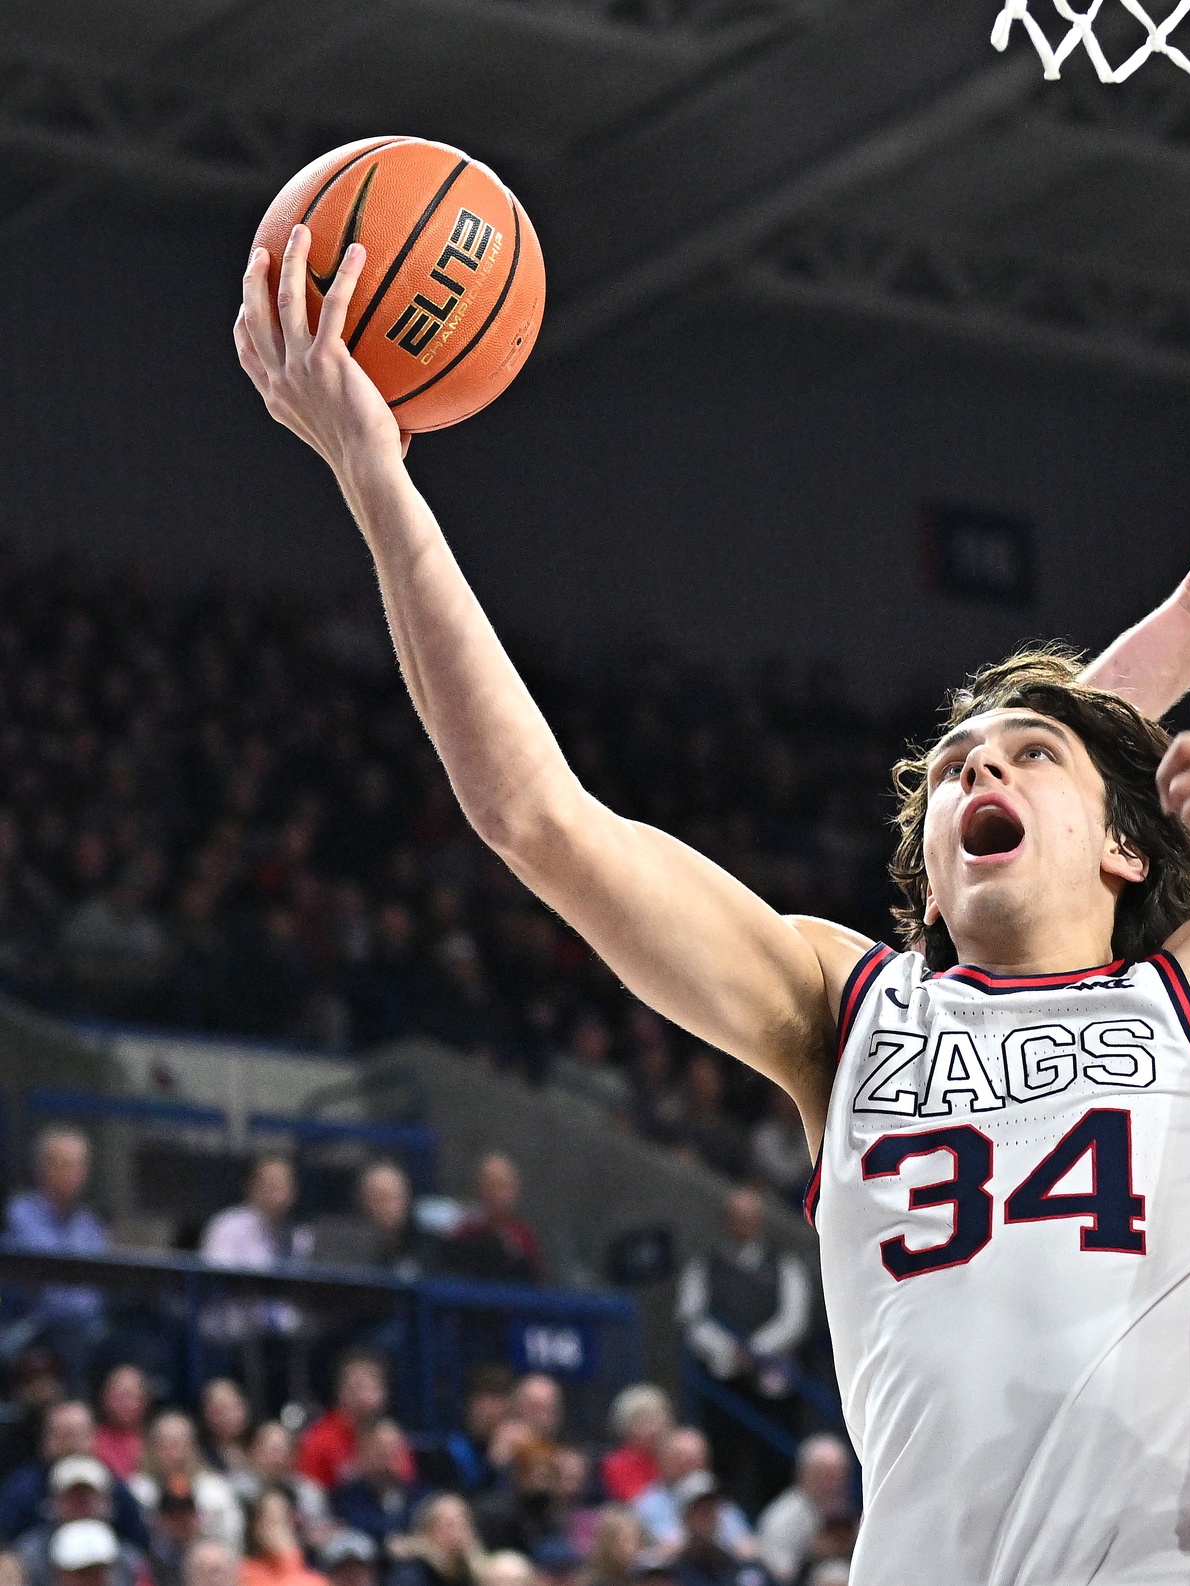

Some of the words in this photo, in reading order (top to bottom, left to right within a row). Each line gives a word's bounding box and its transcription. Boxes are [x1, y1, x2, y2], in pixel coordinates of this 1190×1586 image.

[386, 207, 495, 357] ELITE
[420, 231, 503, 366] CHAMPIONSHIP
[852, 1019, 1156, 1116] ZAGS
[862, 1107, 1146, 1282] 34
